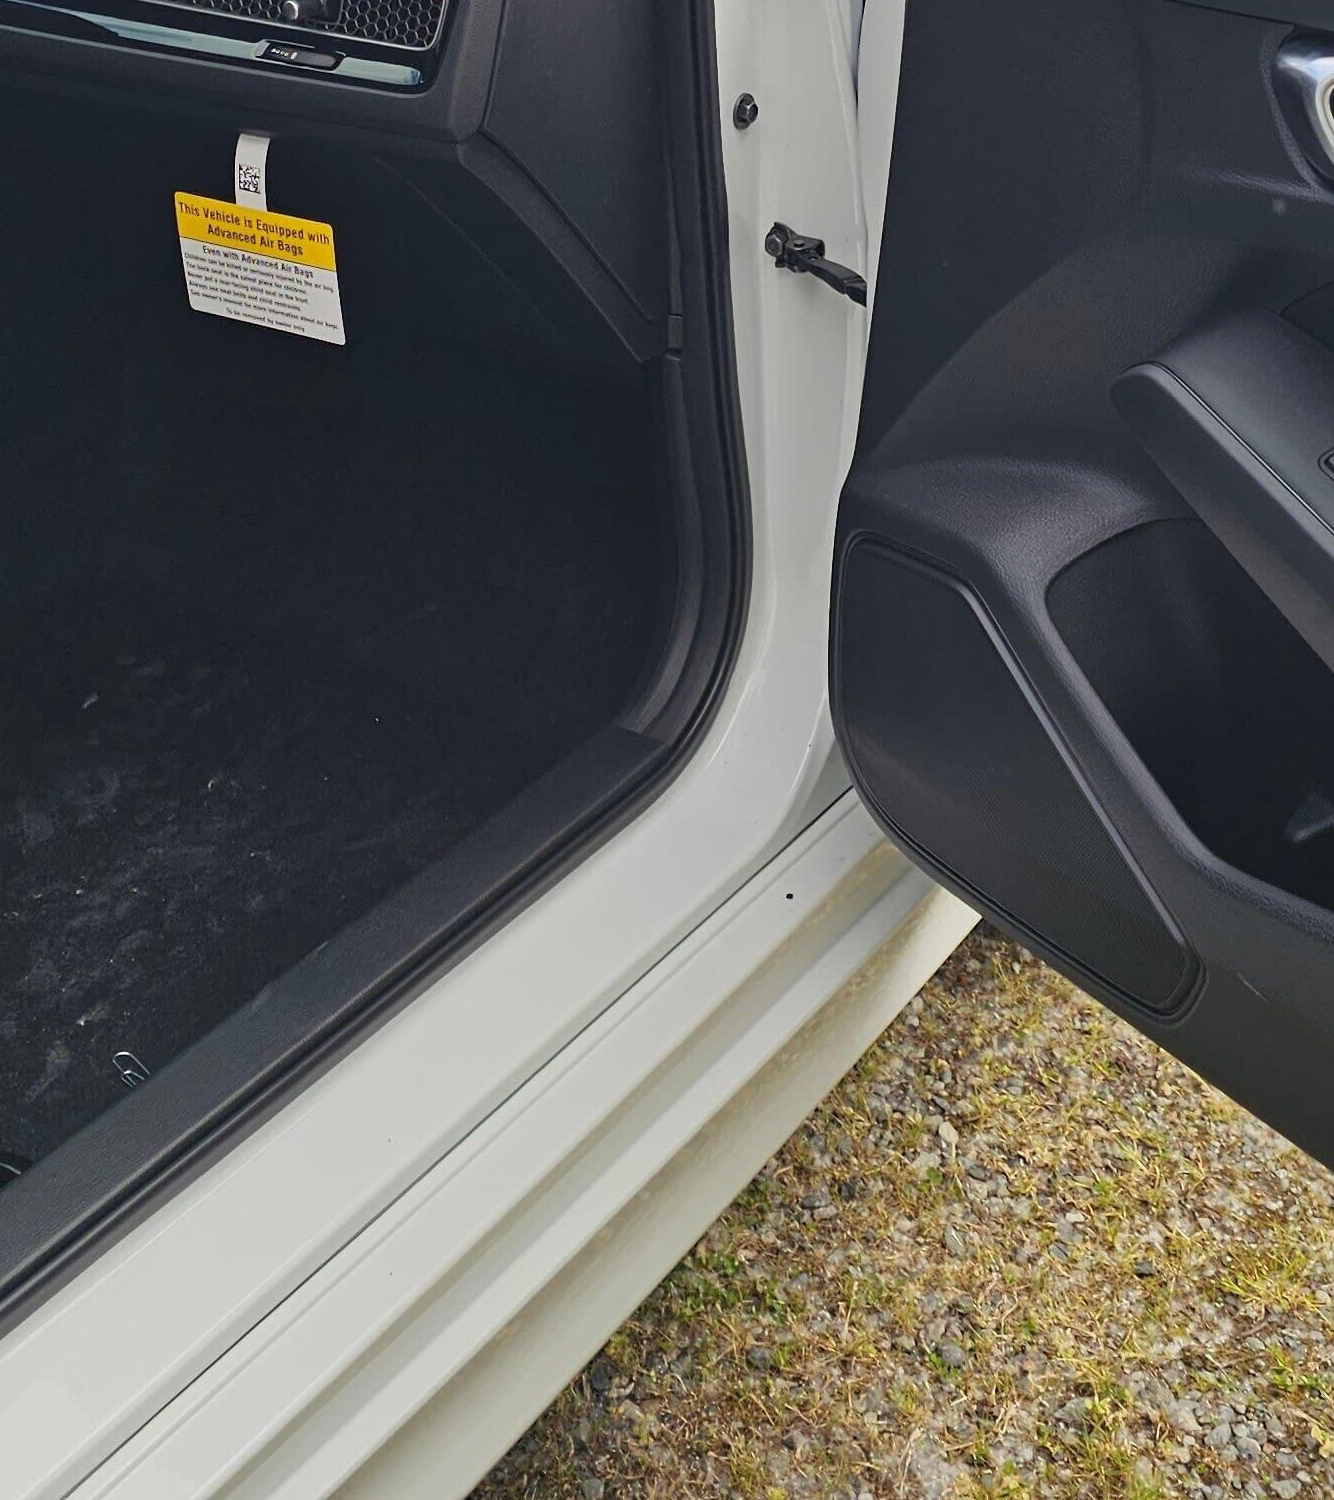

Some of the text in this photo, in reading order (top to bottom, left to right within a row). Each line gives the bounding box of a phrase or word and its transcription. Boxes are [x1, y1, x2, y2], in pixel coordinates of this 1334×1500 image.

[178, 202, 330, 245] This Vehicle is Equipped with
[208, 225, 303, 256] Advanced Air Bags
[203, 246, 313, 277] Even with Advanced Air Bags
